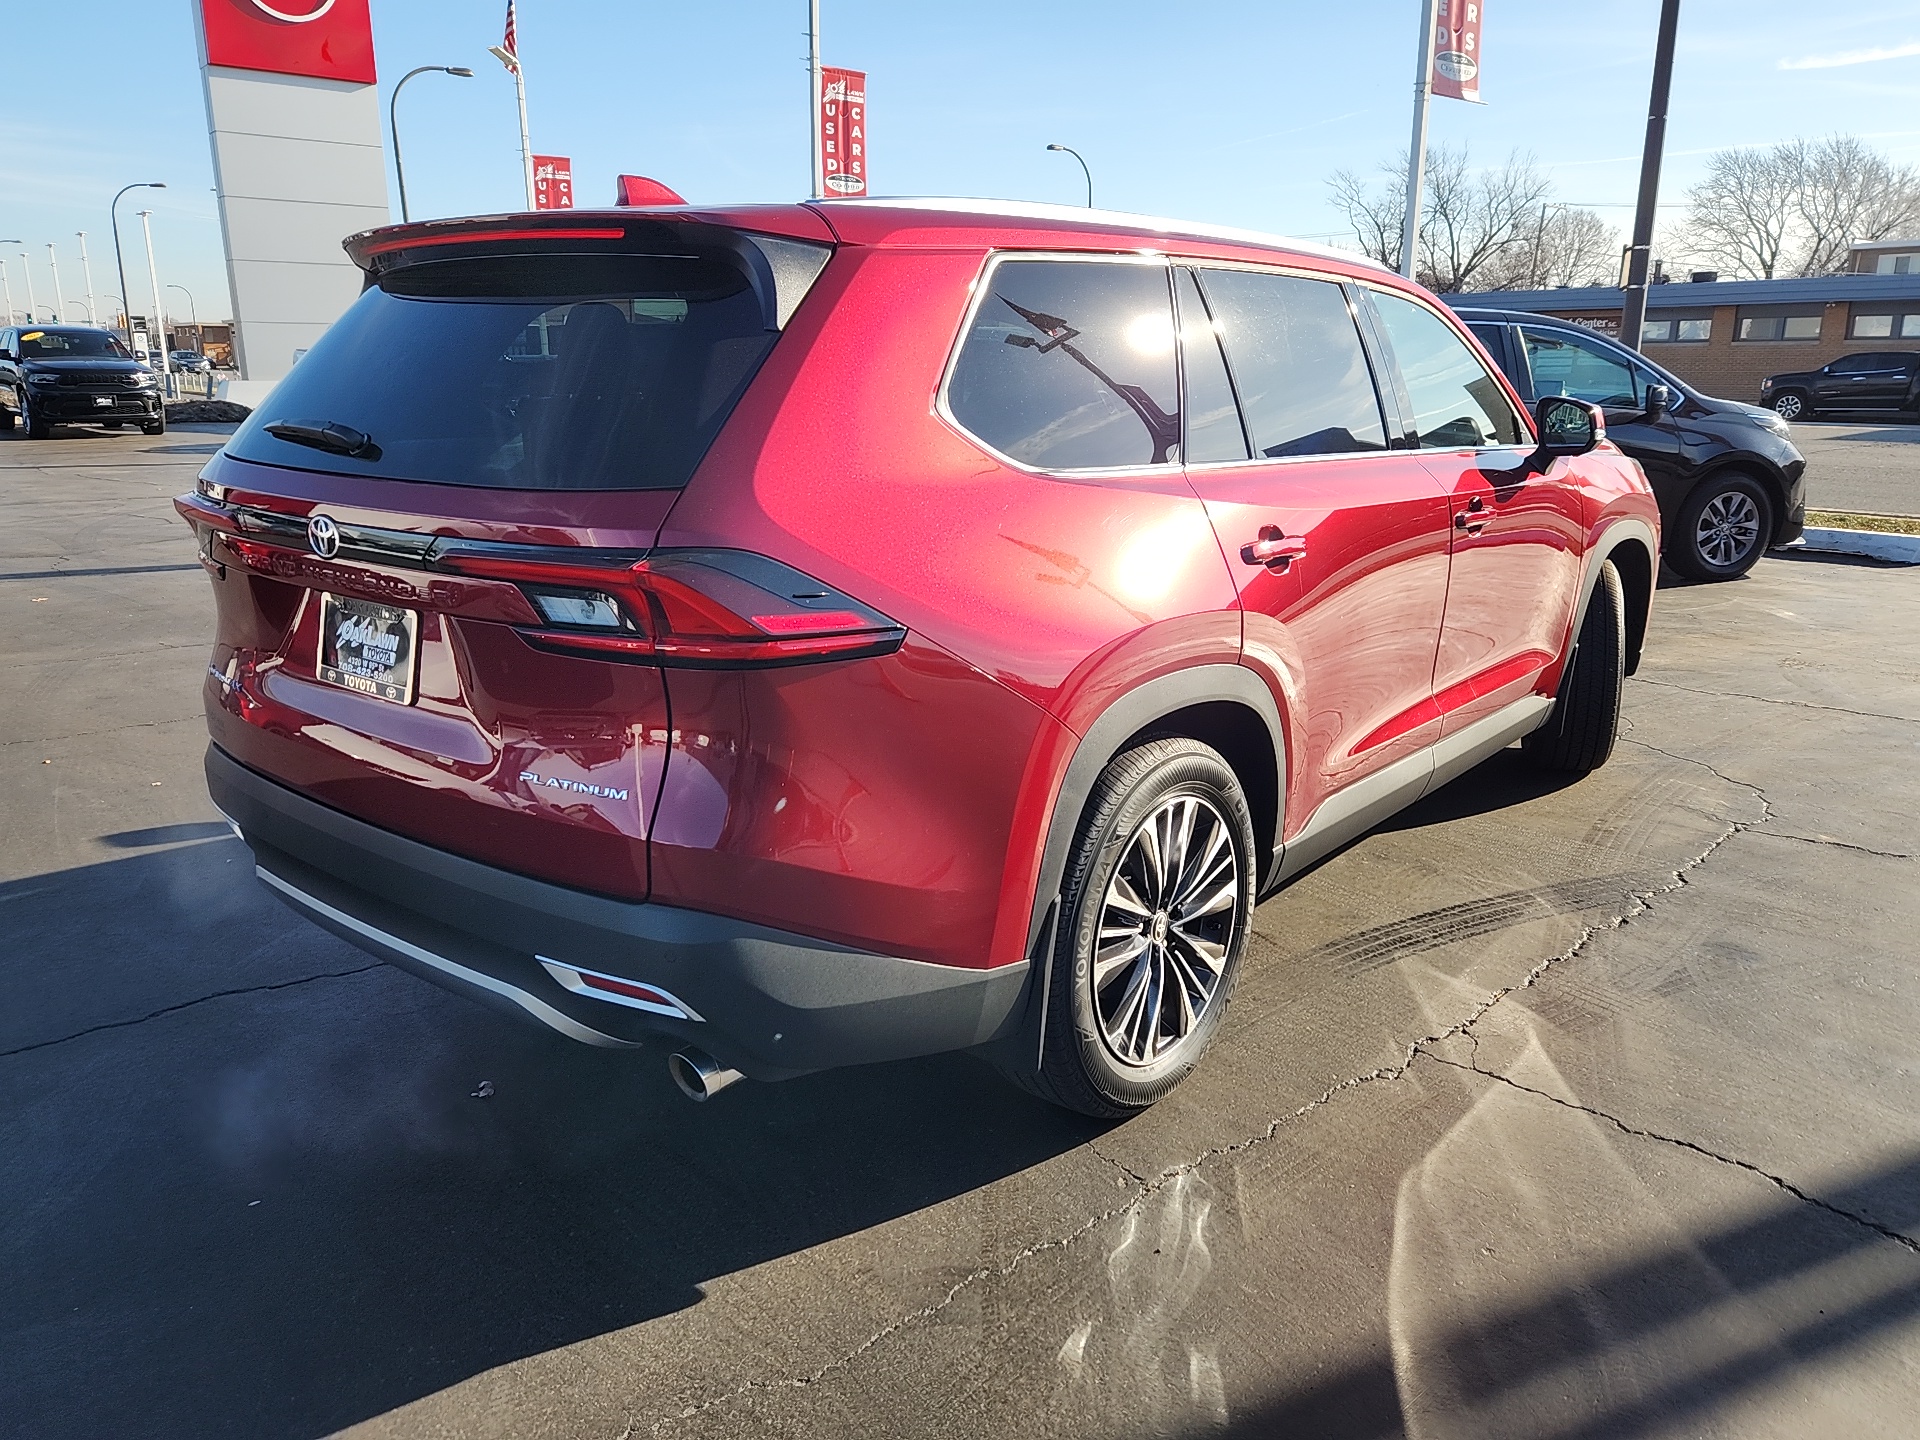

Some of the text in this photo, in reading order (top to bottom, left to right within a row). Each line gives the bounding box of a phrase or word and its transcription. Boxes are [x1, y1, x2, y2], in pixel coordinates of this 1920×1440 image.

[825, 103, 838, 171] USED
[851, 107, 862, 174] CARS
[1575, 317, 1609, 329] Center
[362, 659, 368, 668] W
[366, 647, 392, 663] TOYOTA
[339, 661, 394, 683] 708-423-5200
[343, 674, 377, 693] TOYOTA
[519, 771, 630, 801] PLATINUM
[1075, 861, 1111, 990] YOKOHAMA
